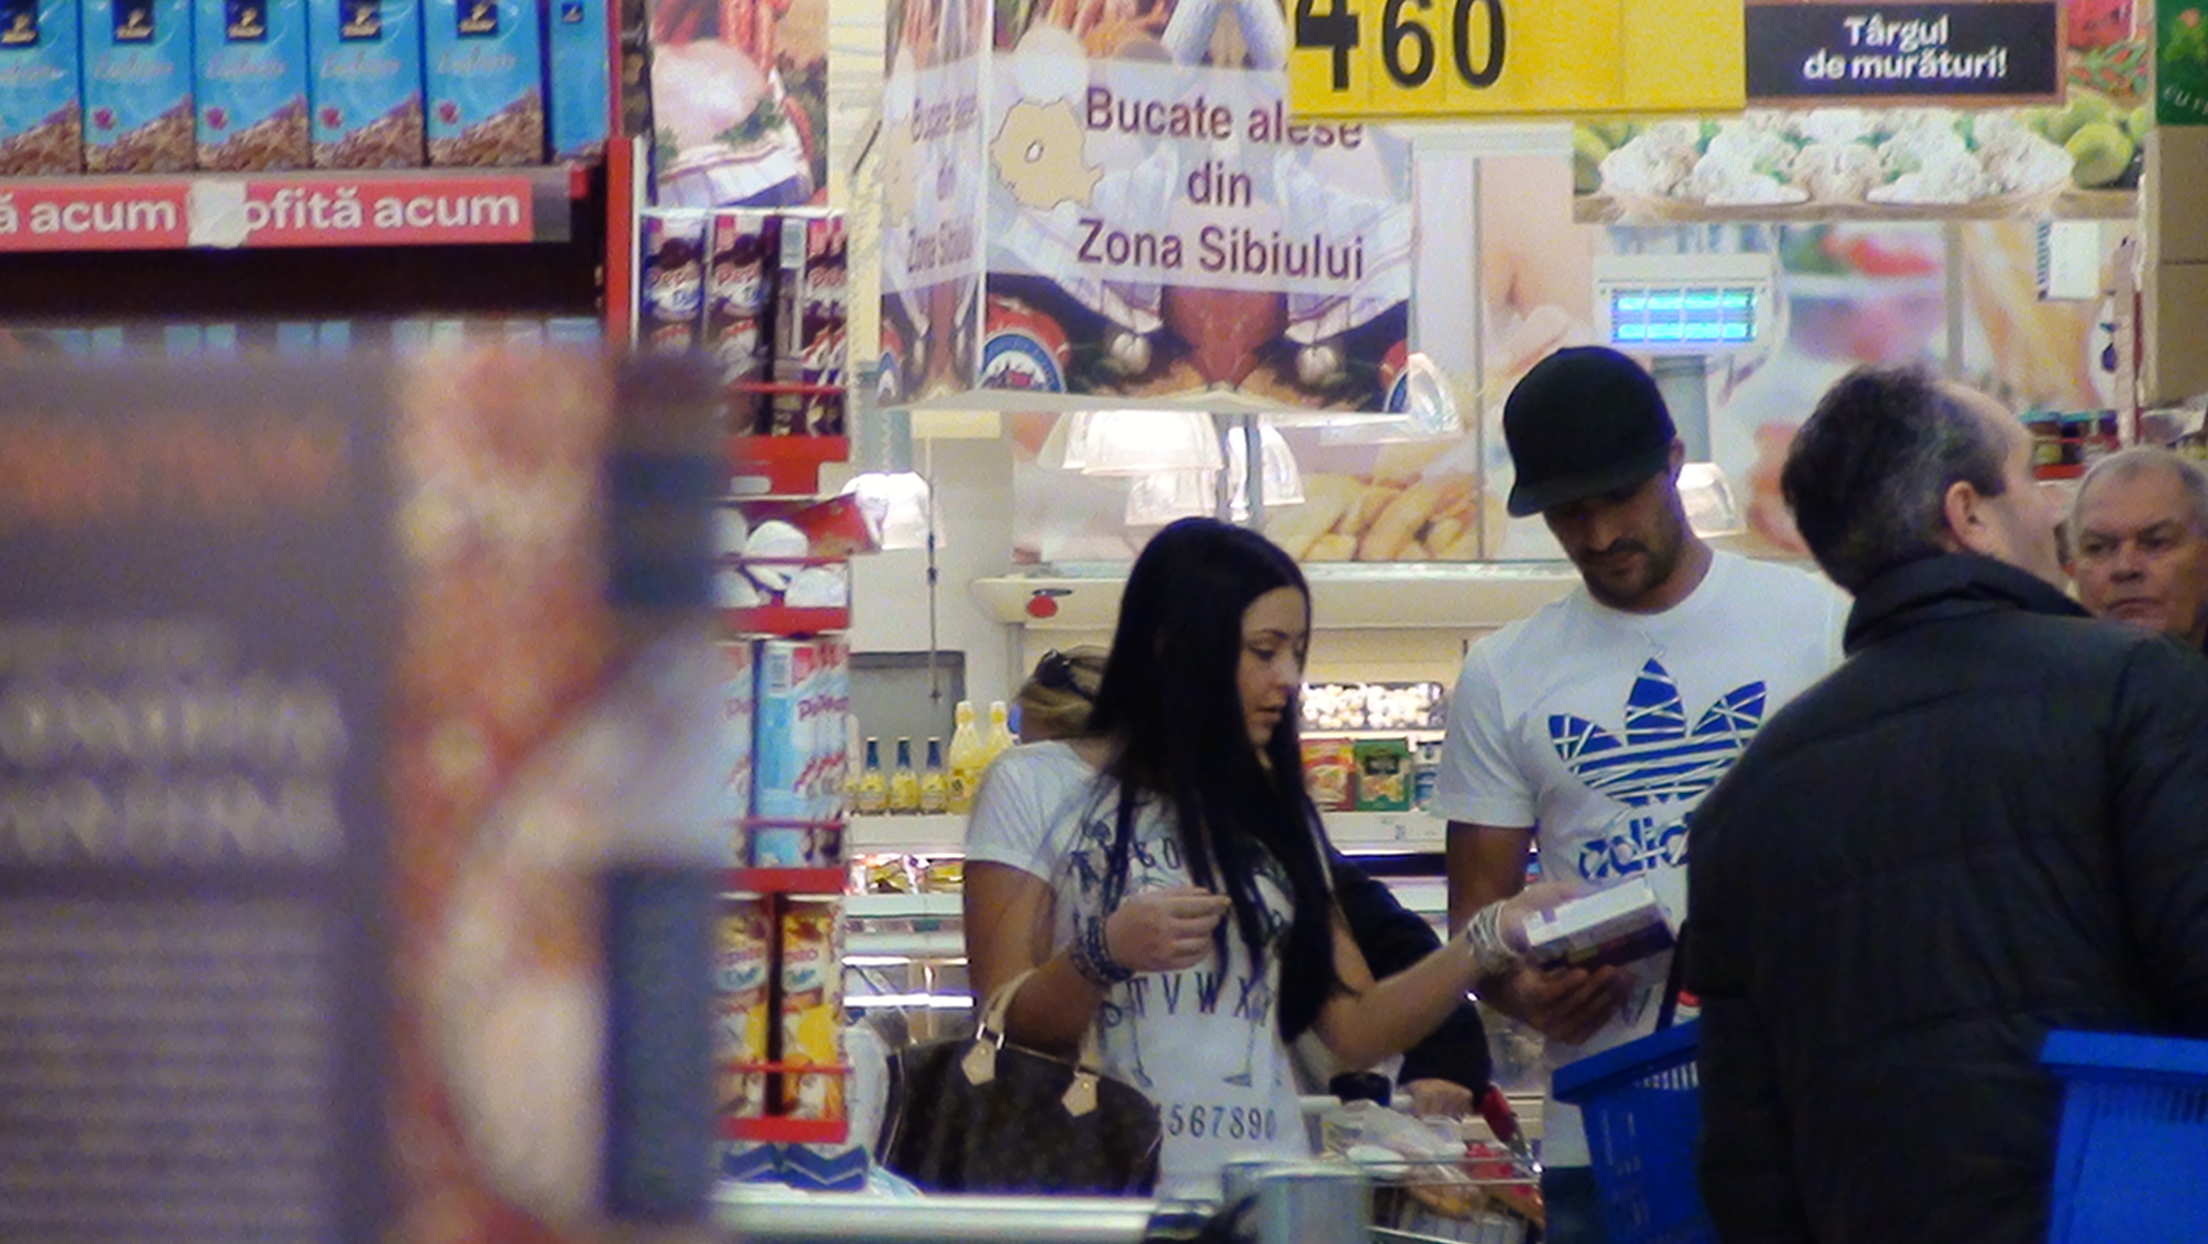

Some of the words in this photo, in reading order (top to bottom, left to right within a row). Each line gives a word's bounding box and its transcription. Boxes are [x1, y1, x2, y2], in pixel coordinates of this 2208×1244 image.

[1843, 13, 1949, 51] Târgul
[1803, 49, 1846, 79] de
[1851, 46, 2007, 79] murături!
[1086, 86, 1232, 138] Bucate
[1187, 160, 1253, 208] din
[30, 200, 177, 234] acum
[245, 187, 363, 231] ofită
[373, 193, 521, 230] acum
[1077, 217, 1183, 269] Zona
[1199, 225, 1364, 281] Sibiului
[1158, 1102, 1279, 1141] 567890
